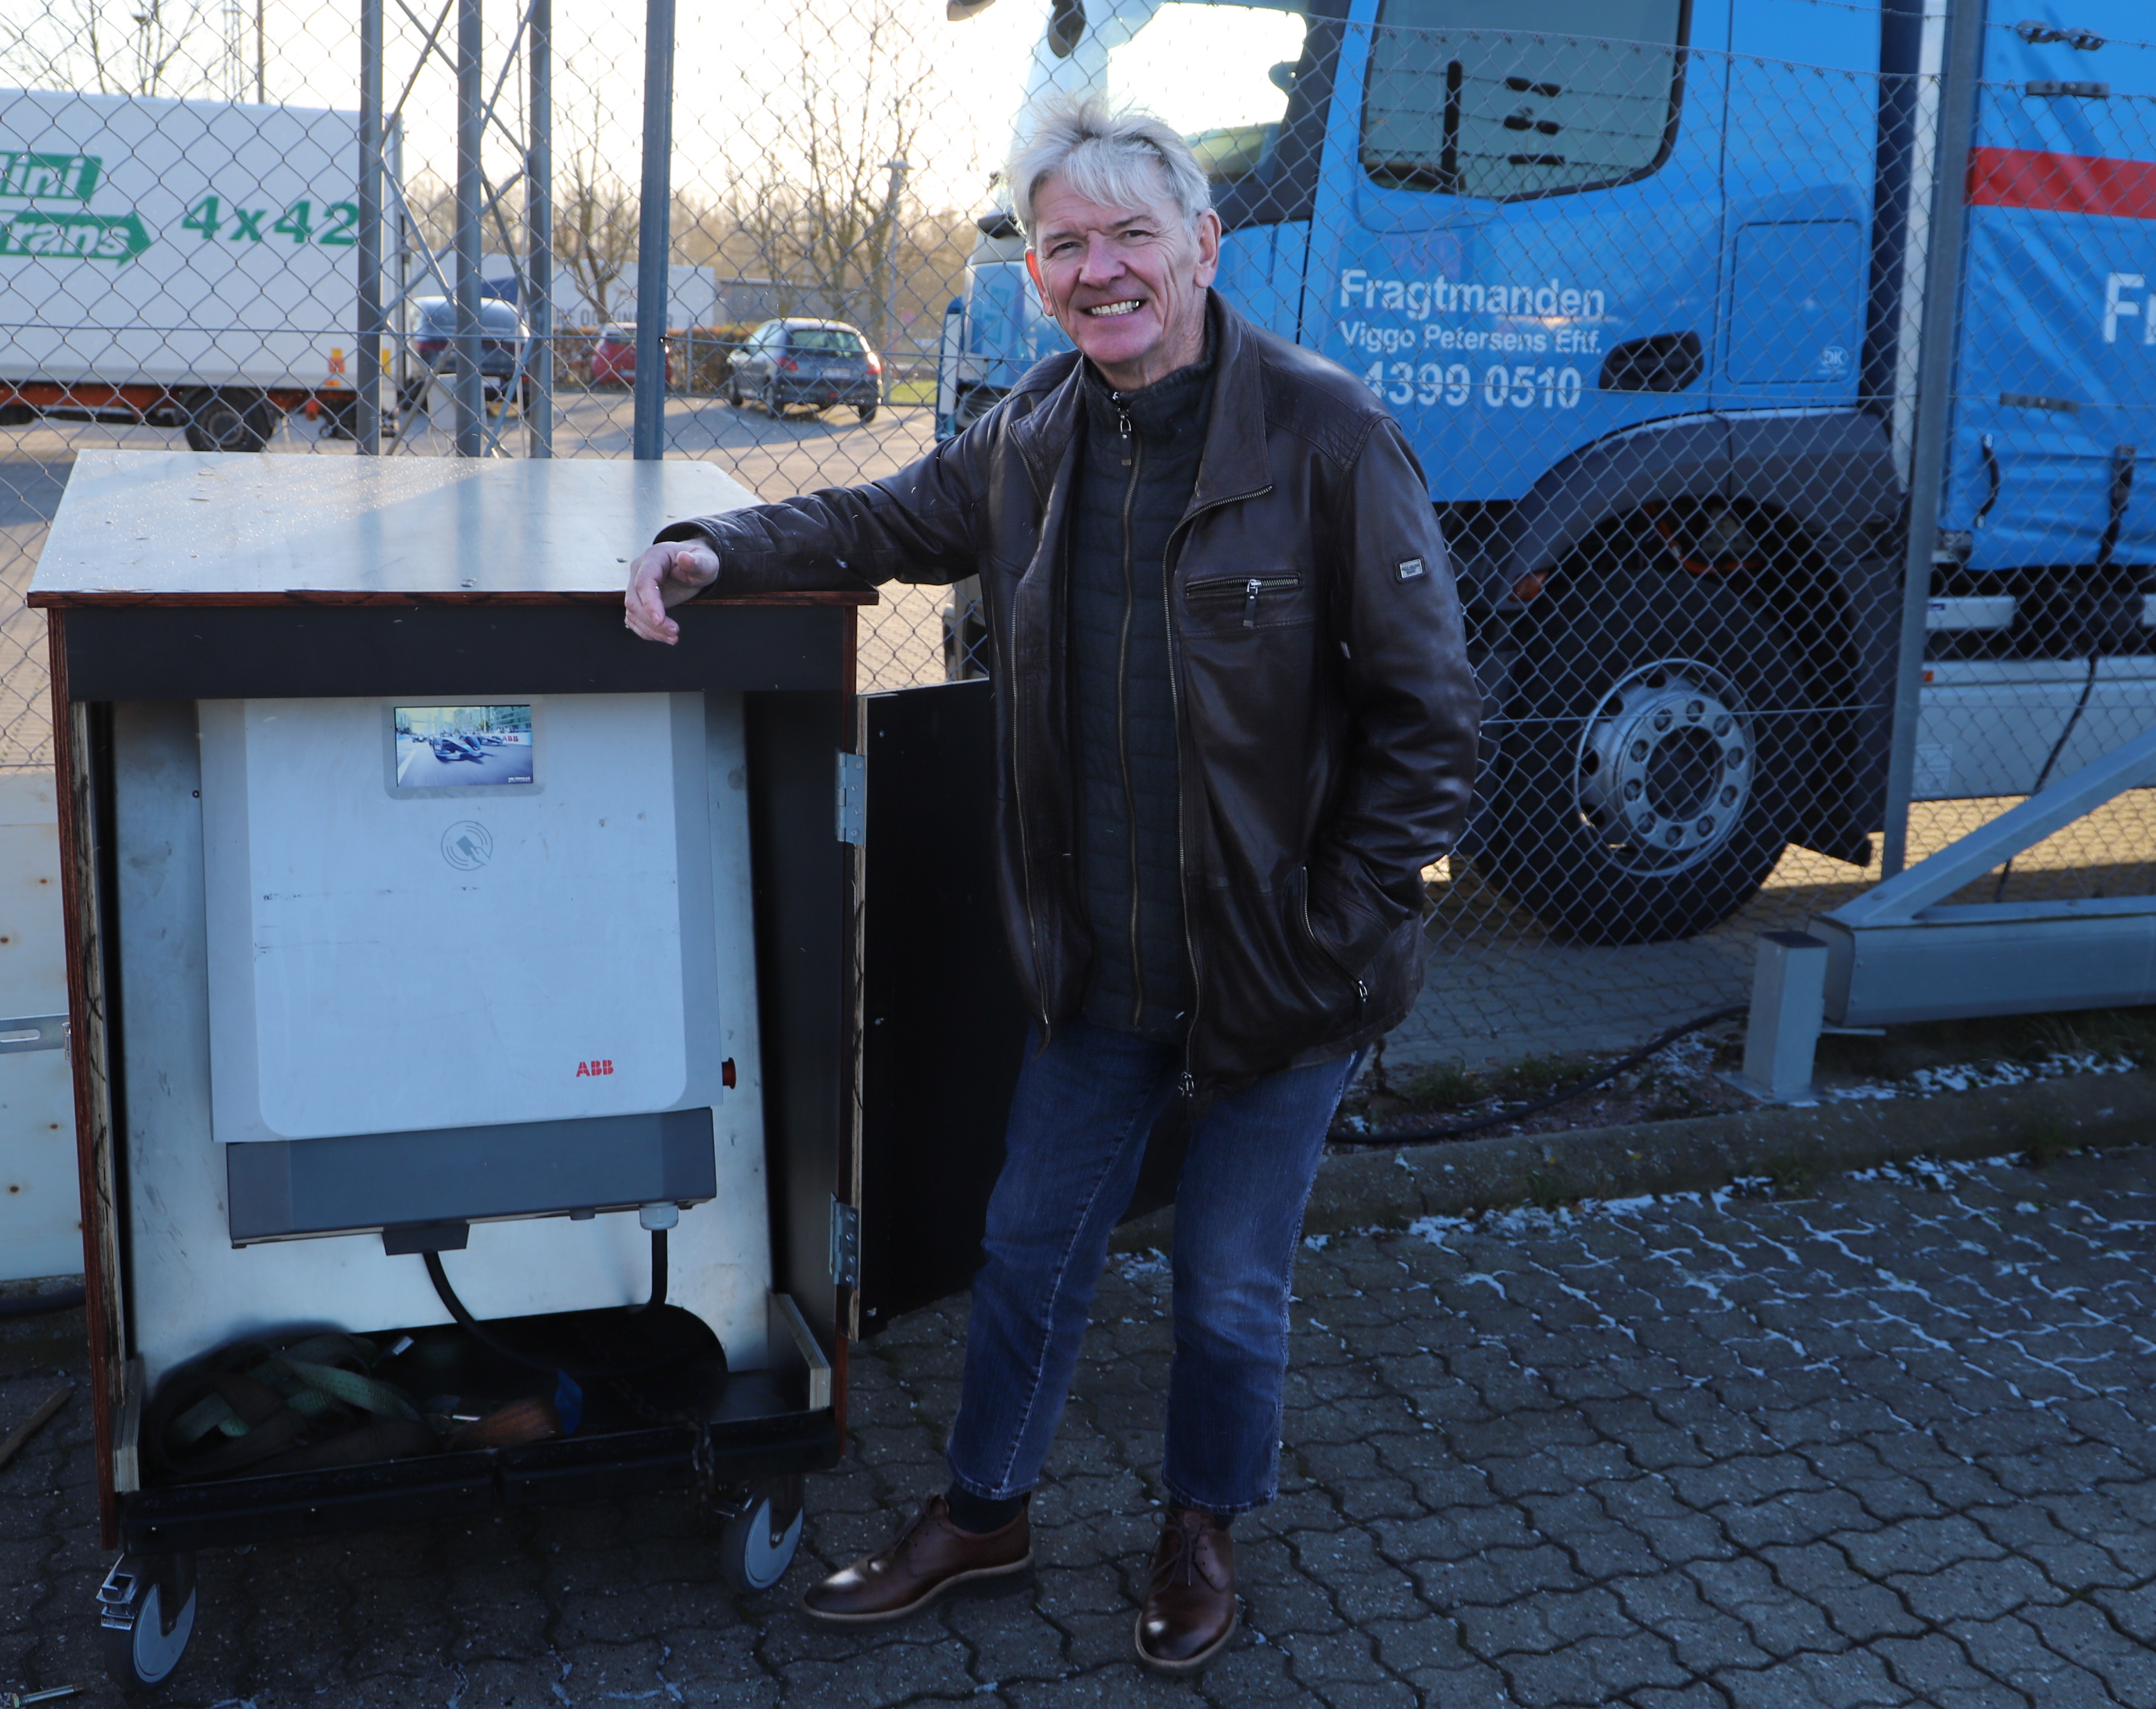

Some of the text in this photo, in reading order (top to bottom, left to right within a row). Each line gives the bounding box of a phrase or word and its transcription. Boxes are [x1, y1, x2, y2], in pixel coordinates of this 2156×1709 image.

[0, 154, 85, 197] ini
[0, 211, 131, 256] rans
[182, 195, 359, 245] 4x42
[1341, 269, 1605, 319] Fragtmanden
[1340, 321, 1416, 353] Viggo
[1425, 323, 1547, 352] Petersens
[1364, 361, 1582, 409] 4399 0510
[575, 1060, 613, 1078] ABB
